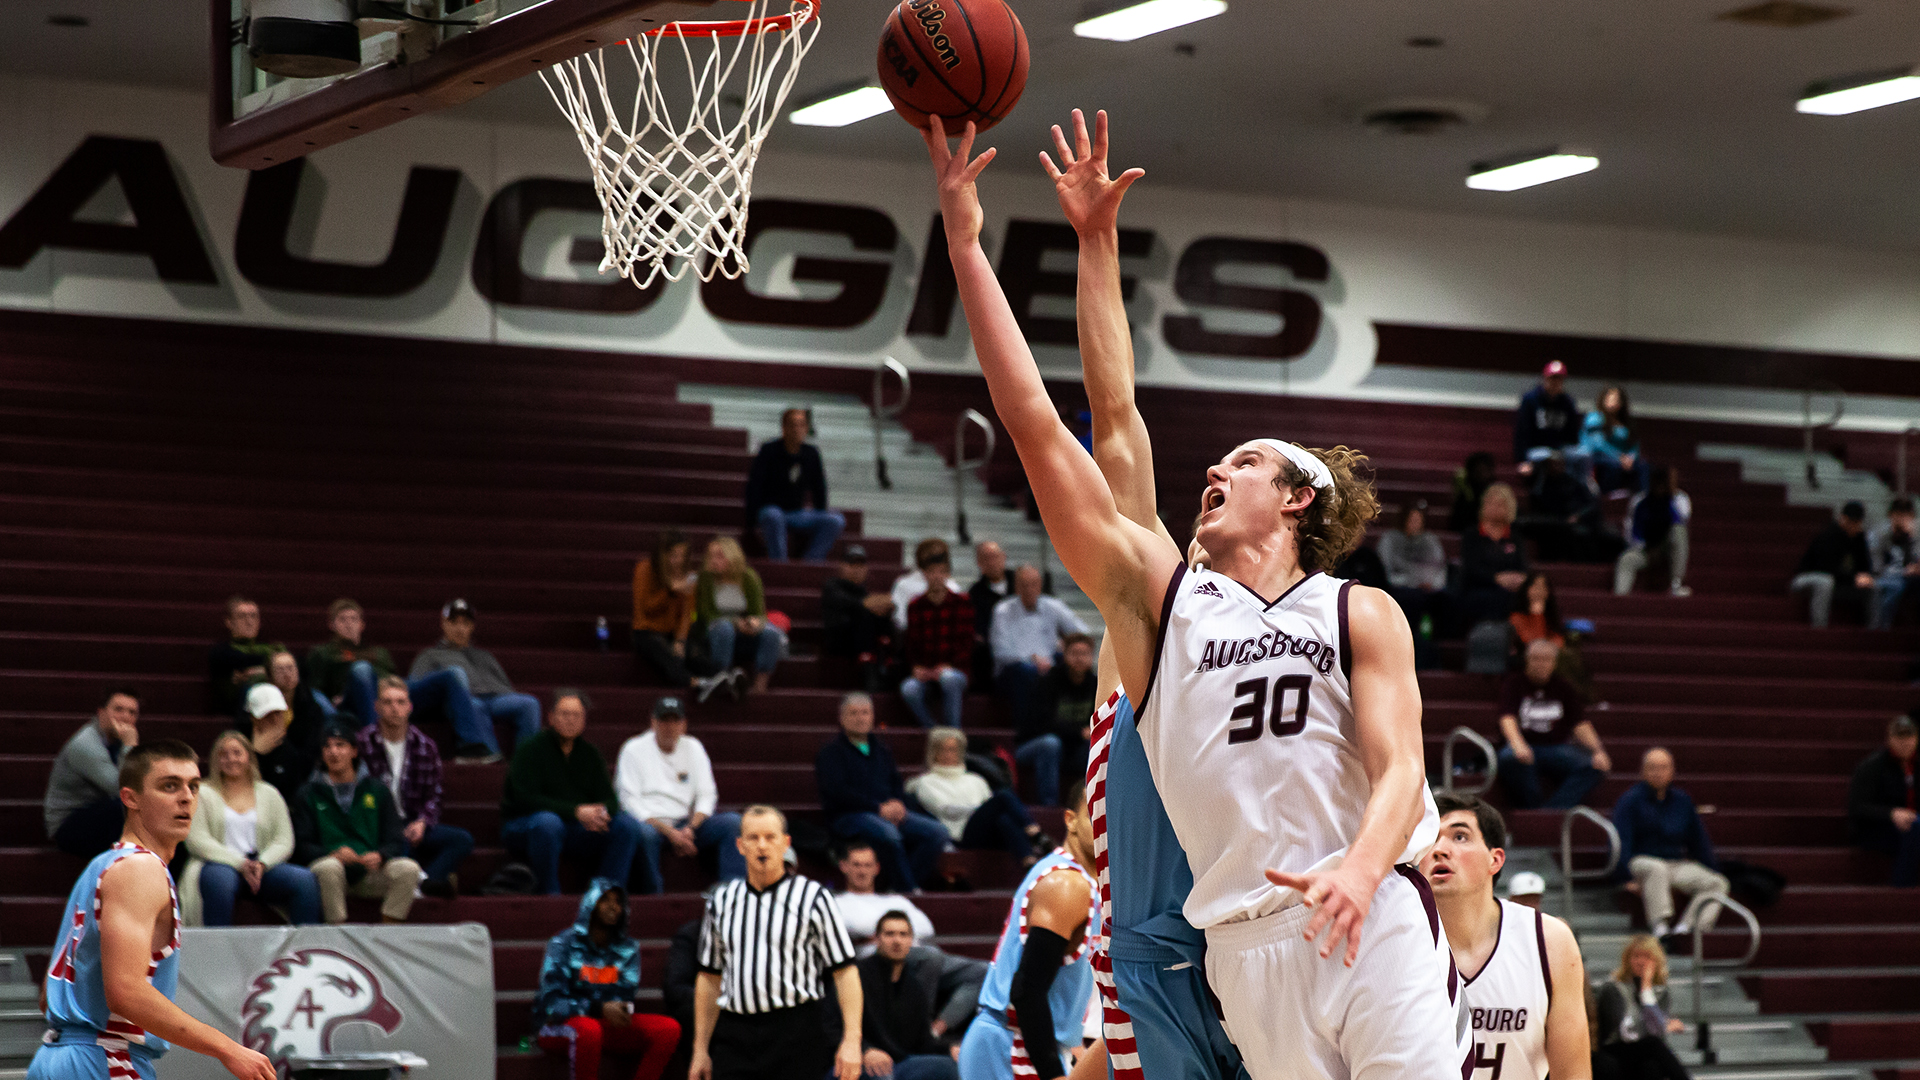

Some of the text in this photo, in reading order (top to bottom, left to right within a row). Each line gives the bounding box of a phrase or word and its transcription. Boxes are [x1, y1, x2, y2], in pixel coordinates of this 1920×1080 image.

[0, 135, 1330, 358] AUGGIES
[1193, 588, 1224, 600] adidas
[1196, 630, 1337, 677] AUGSBURG
[1228, 674, 1313, 745] 30
[1471, 1007, 1528, 1032] BURG
[1474, 1042, 1506, 1080] 4
